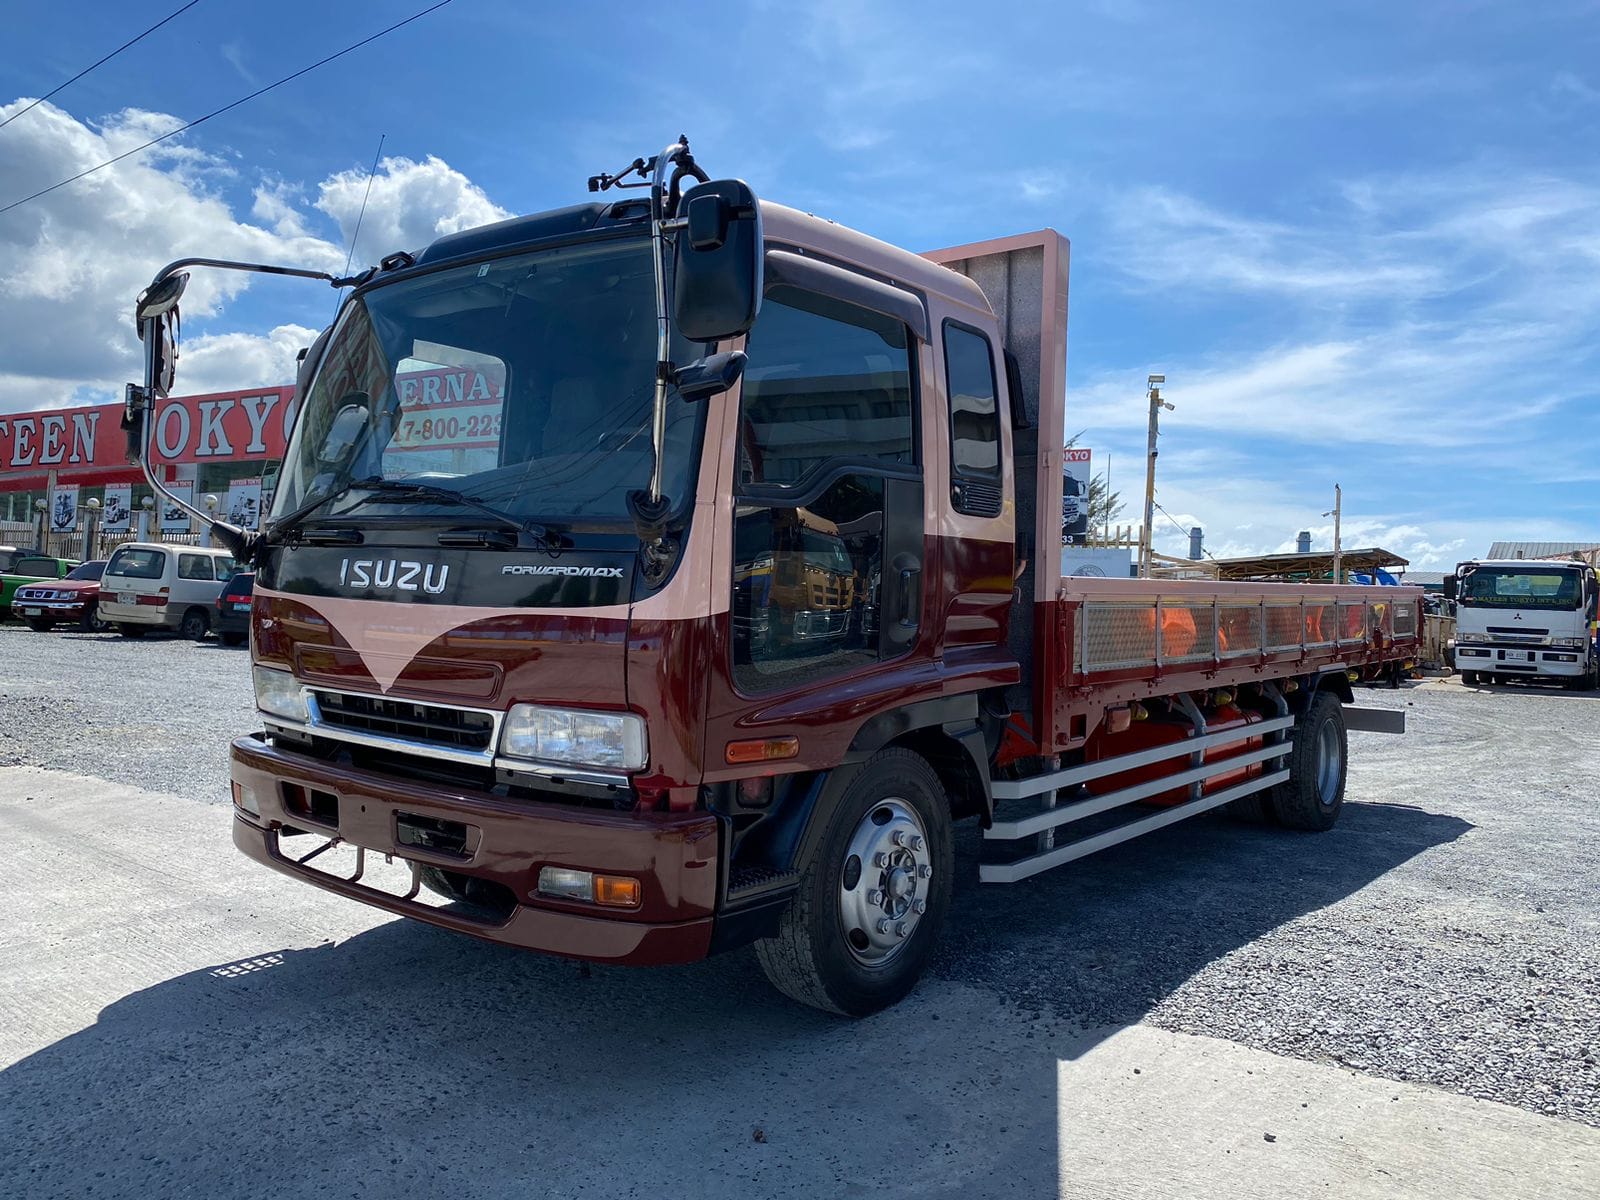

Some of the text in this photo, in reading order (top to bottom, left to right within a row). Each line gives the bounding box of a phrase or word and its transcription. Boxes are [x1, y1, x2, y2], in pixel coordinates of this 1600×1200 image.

[399, 372, 505, 408] ERNA
[126, 394, 295, 460] OKY
[1063, 451, 1089, 460] KYO
[339, 558, 450, 594] ISUZU
[501, 565, 624, 578] FORWARDMAX
